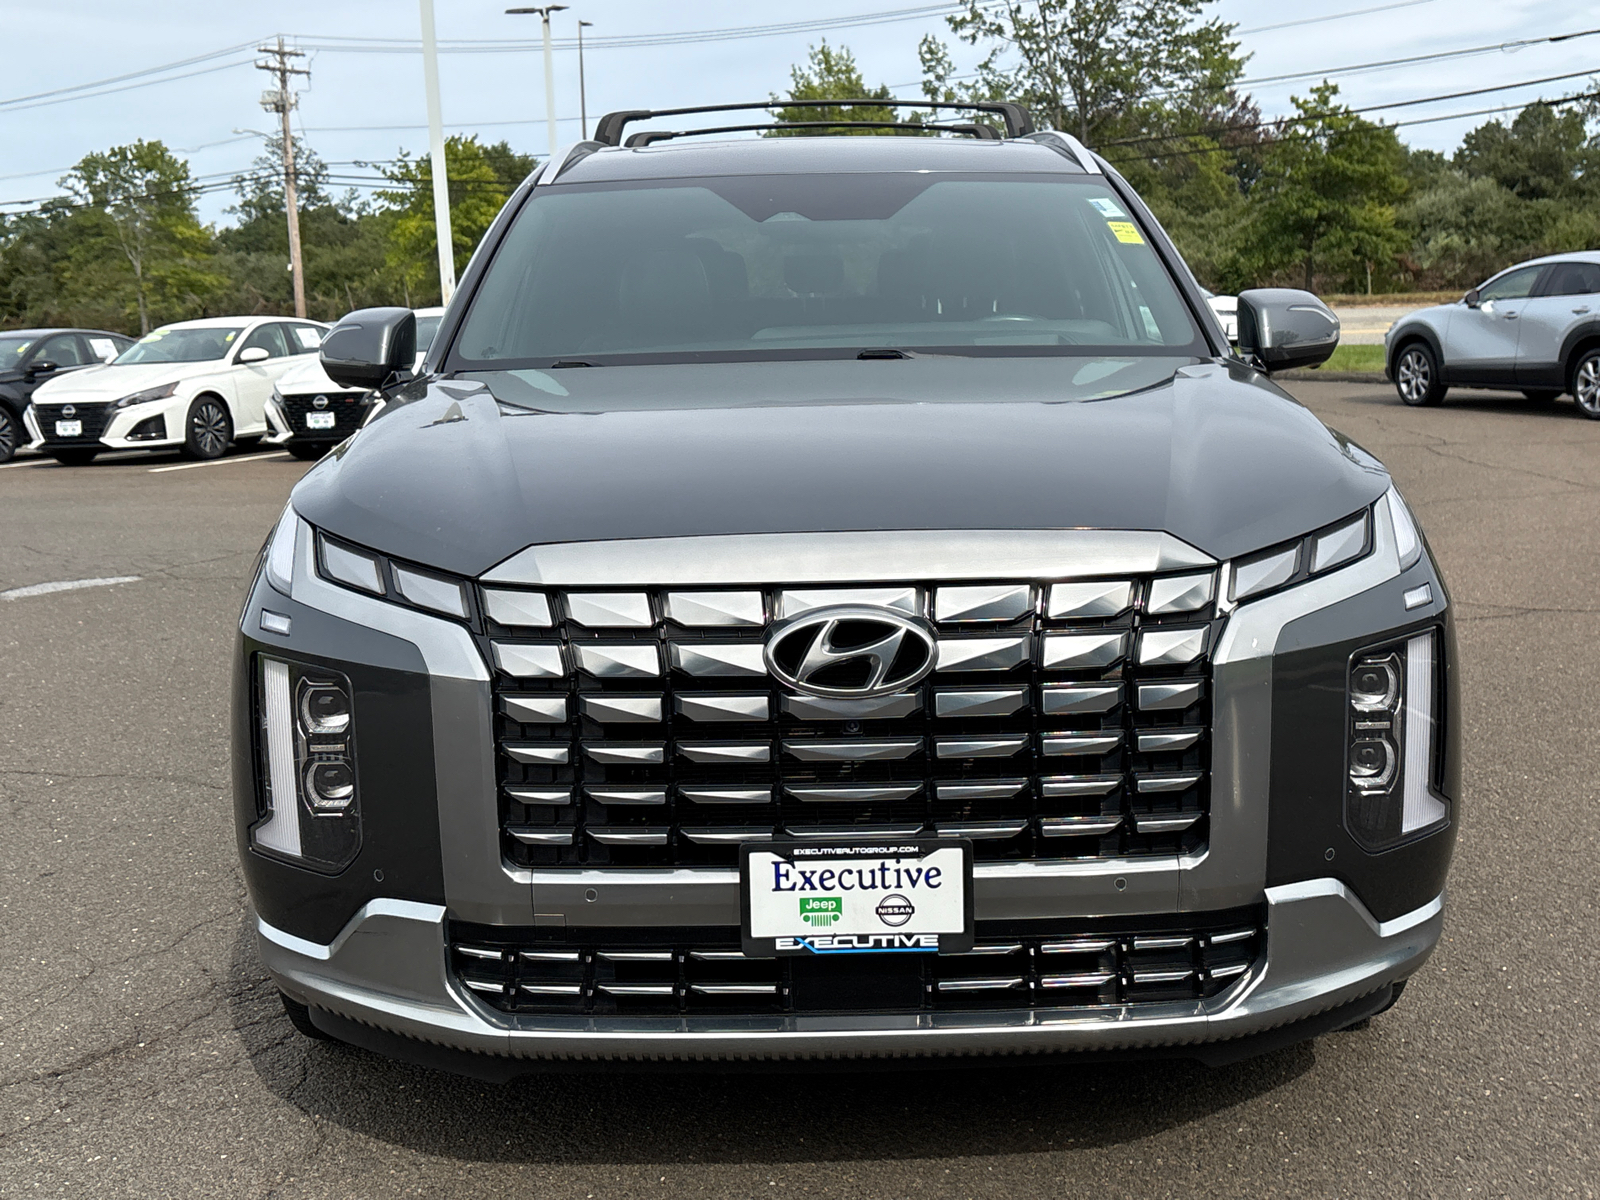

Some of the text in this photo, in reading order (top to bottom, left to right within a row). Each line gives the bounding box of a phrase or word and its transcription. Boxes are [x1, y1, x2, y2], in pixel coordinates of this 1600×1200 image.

[793, 846, 919, 856] EXECUTIVEAUTOGROUP.COM
[771, 858, 942, 892] Executive
[805, 899, 837, 910] Jeep
[775, 934, 939, 951] EXECUTIVE
